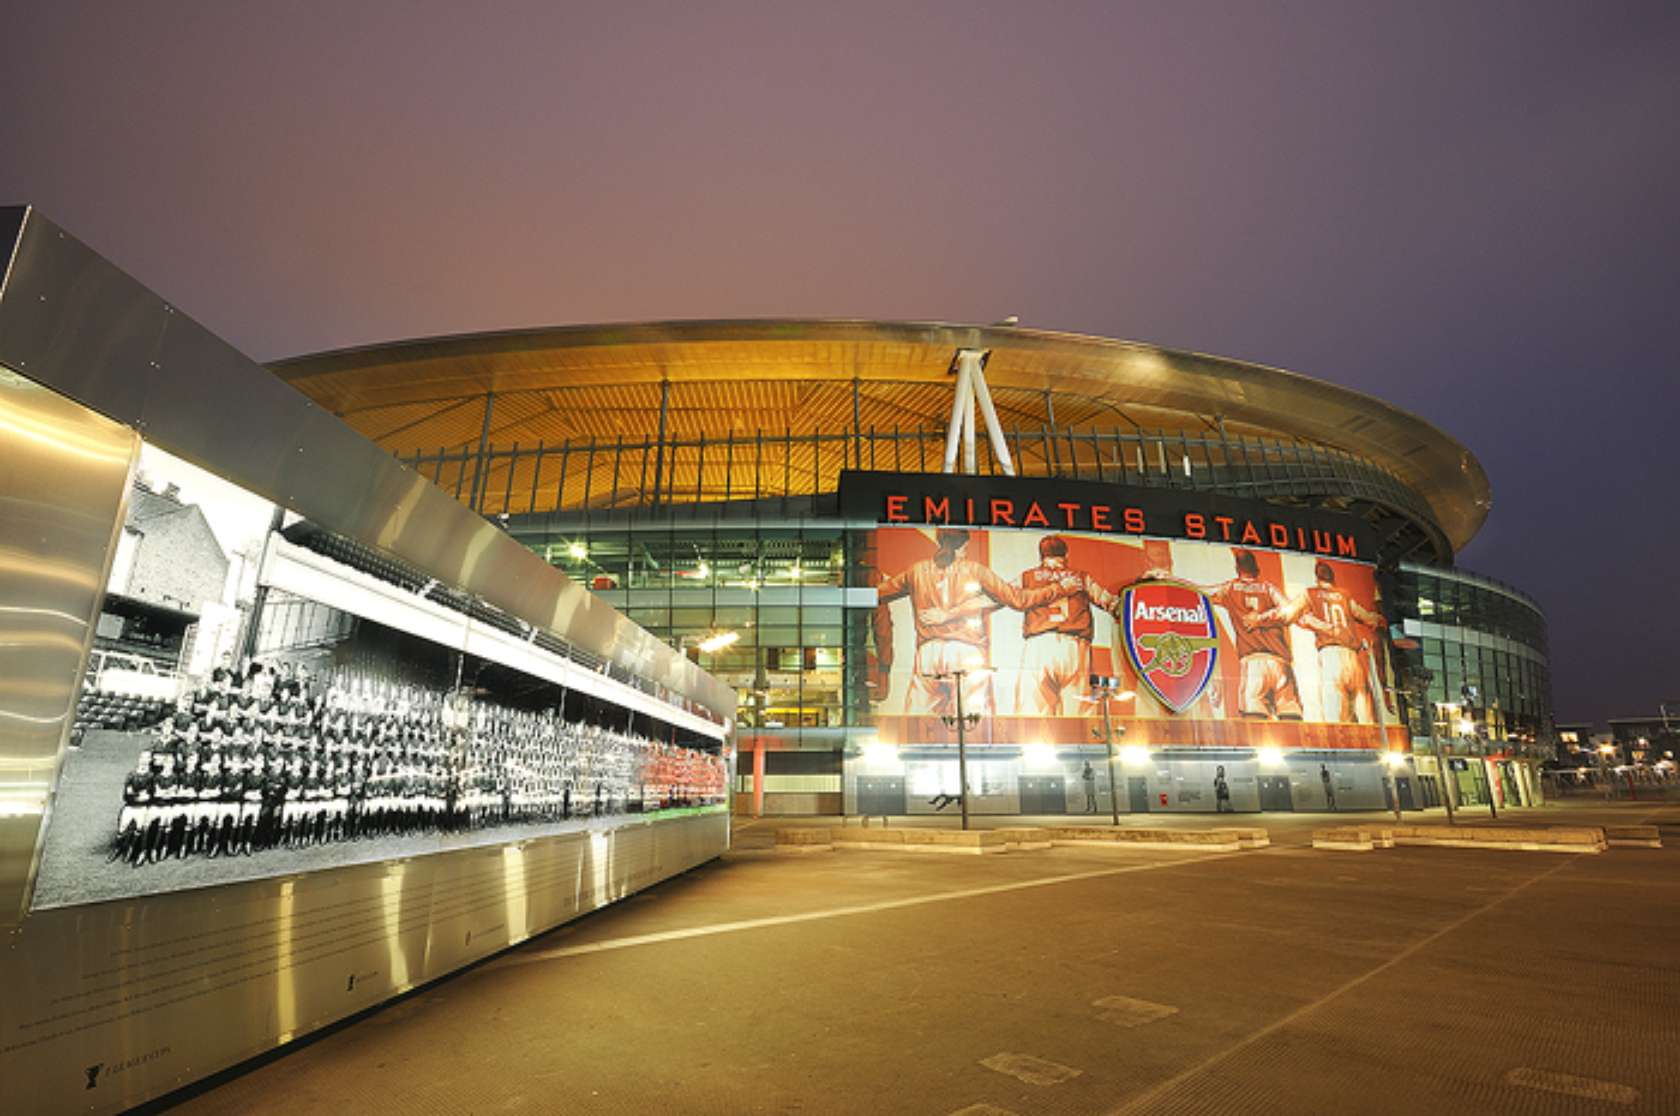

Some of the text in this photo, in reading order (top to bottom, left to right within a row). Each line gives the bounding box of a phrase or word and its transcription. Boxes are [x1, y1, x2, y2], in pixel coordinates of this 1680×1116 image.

[887, 495, 1358, 558] EMIRATES STADIUM
[1134, 600, 1206, 623] Arsenal
